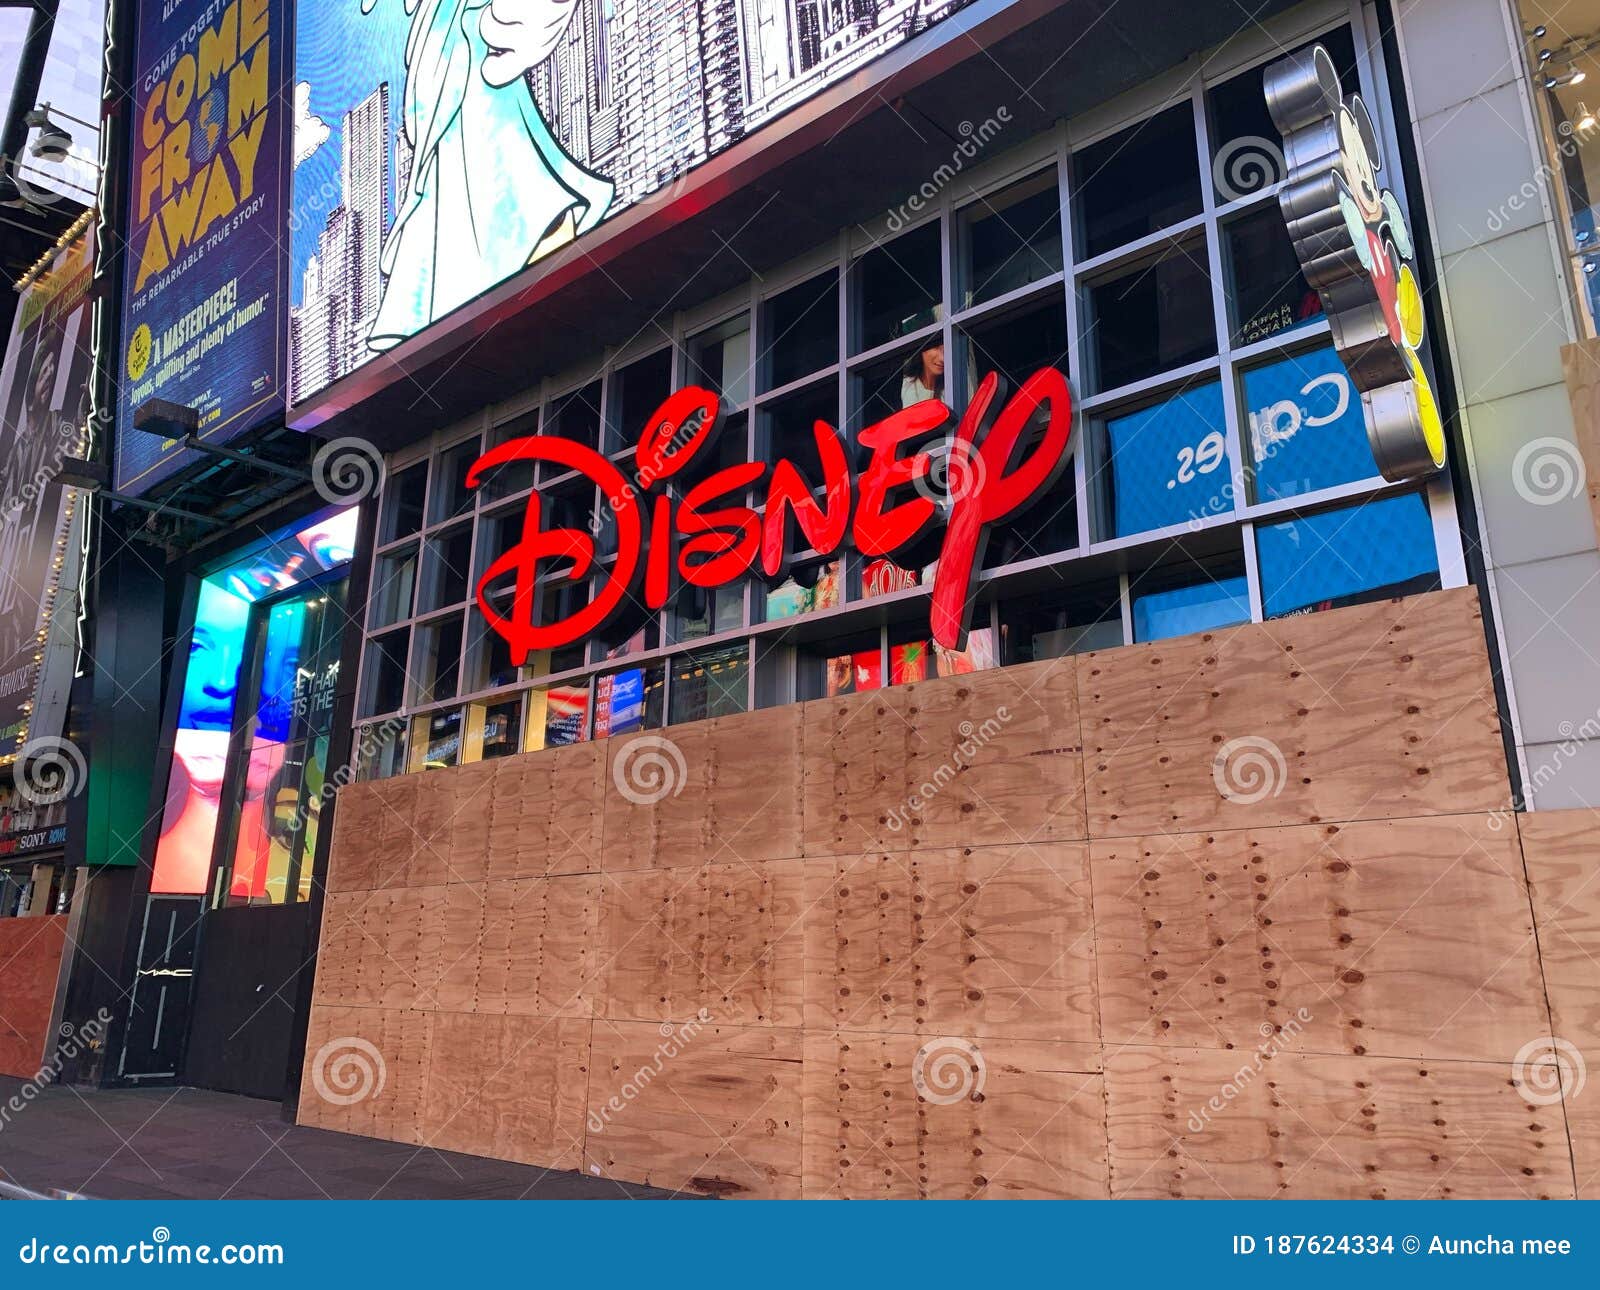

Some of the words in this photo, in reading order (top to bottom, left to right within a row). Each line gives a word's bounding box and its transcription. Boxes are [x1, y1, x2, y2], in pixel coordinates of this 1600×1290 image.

[142, 0, 270, 149] COME
[144, 45, 177, 92] COME
[180, 0, 227, 52] TOGET
[133, 109, 269, 294] AWAY
[131, 292, 147, 315] THE
[148, 245, 204, 300] REMARKABLE
[206, 228, 230, 254] TRUE
[232, 193, 266, 231] STORY
[155, 353, 185, 389] uplifting
[186, 338, 200, 367] and
[201, 323, 225, 359] plenty
[226, 314, 236, 337] of
[163, 277, 238, 360] MASTERPIECE!
[313, 689, 335, 712] THE
[20, 832, 47, 849] SONY
